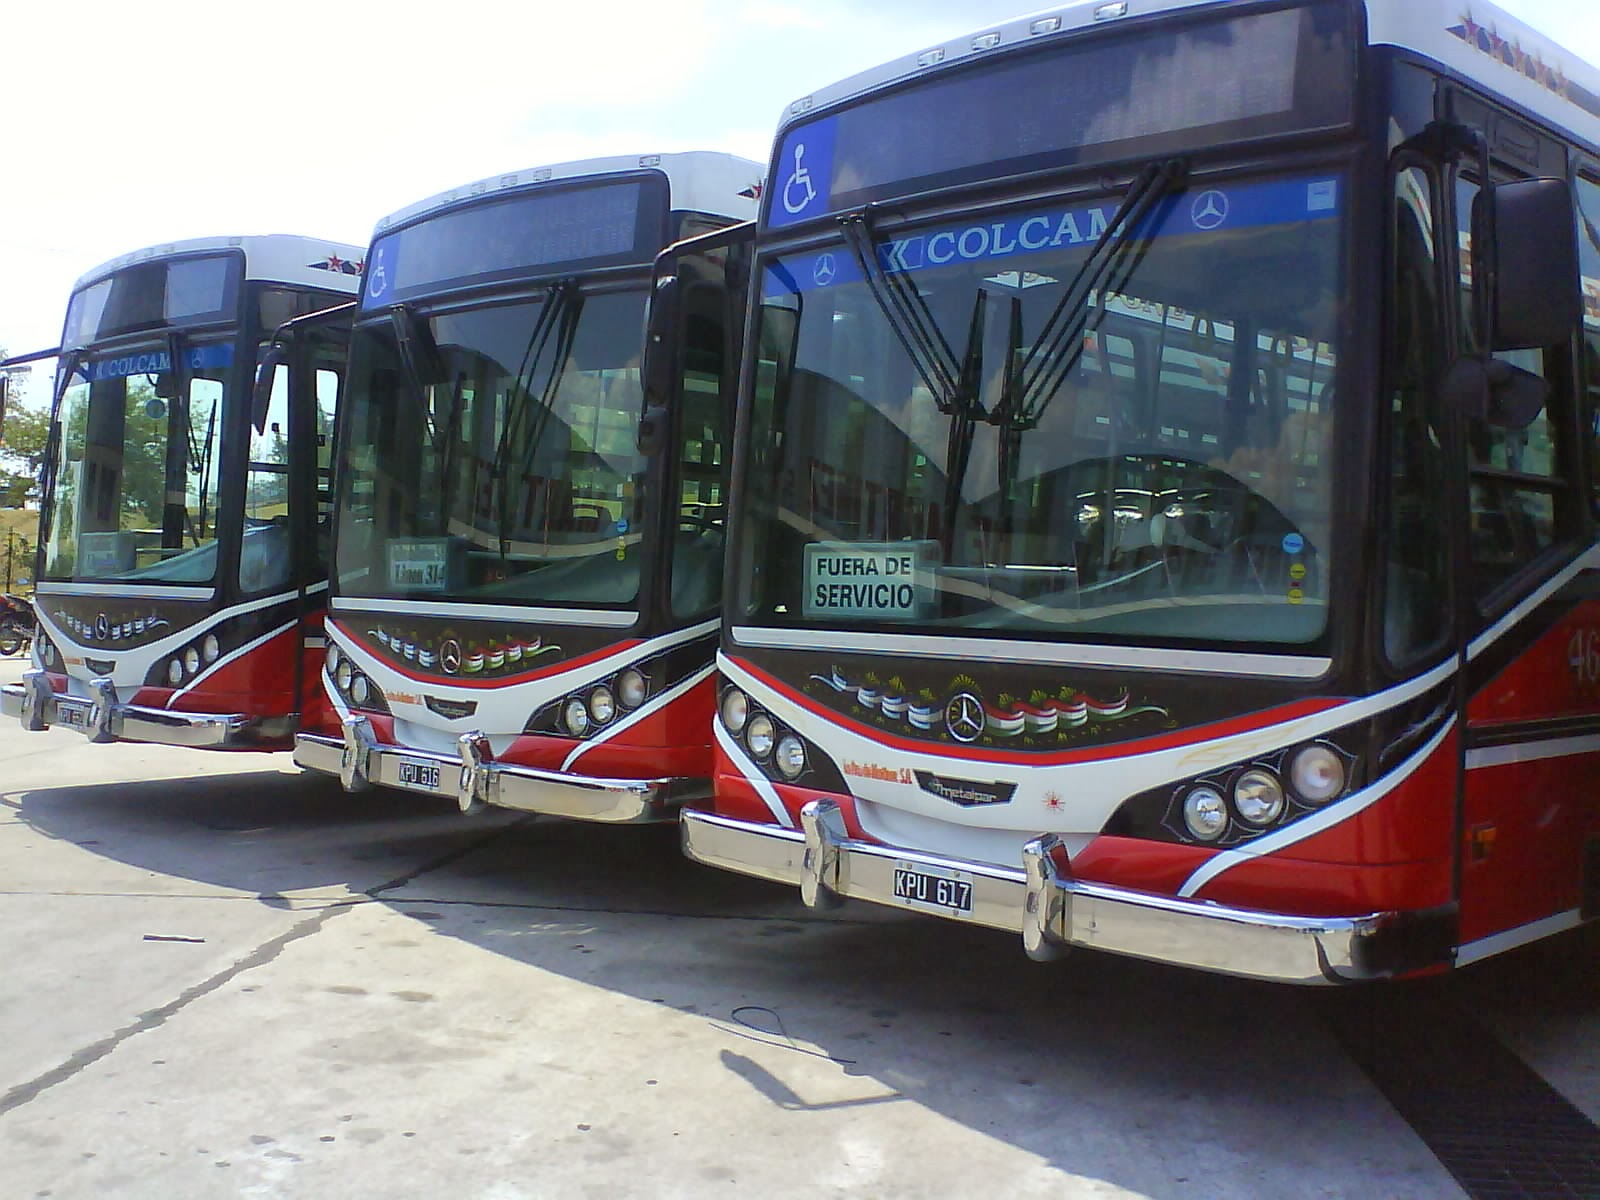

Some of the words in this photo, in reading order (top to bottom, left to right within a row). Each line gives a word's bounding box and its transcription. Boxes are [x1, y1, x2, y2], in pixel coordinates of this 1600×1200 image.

[109, 351, 171, 377] COLCAM
[817, 558, 879, 576] FUERA
[885, 557, 911, 575] DE
[815, 584, 914, 608] SERVICIO
[400, 764, 417, 782] KPU
[421, 767, 439, 786] 616
[896, 871, 928, 900] KPU
[937, 880, 971, 908] 617
